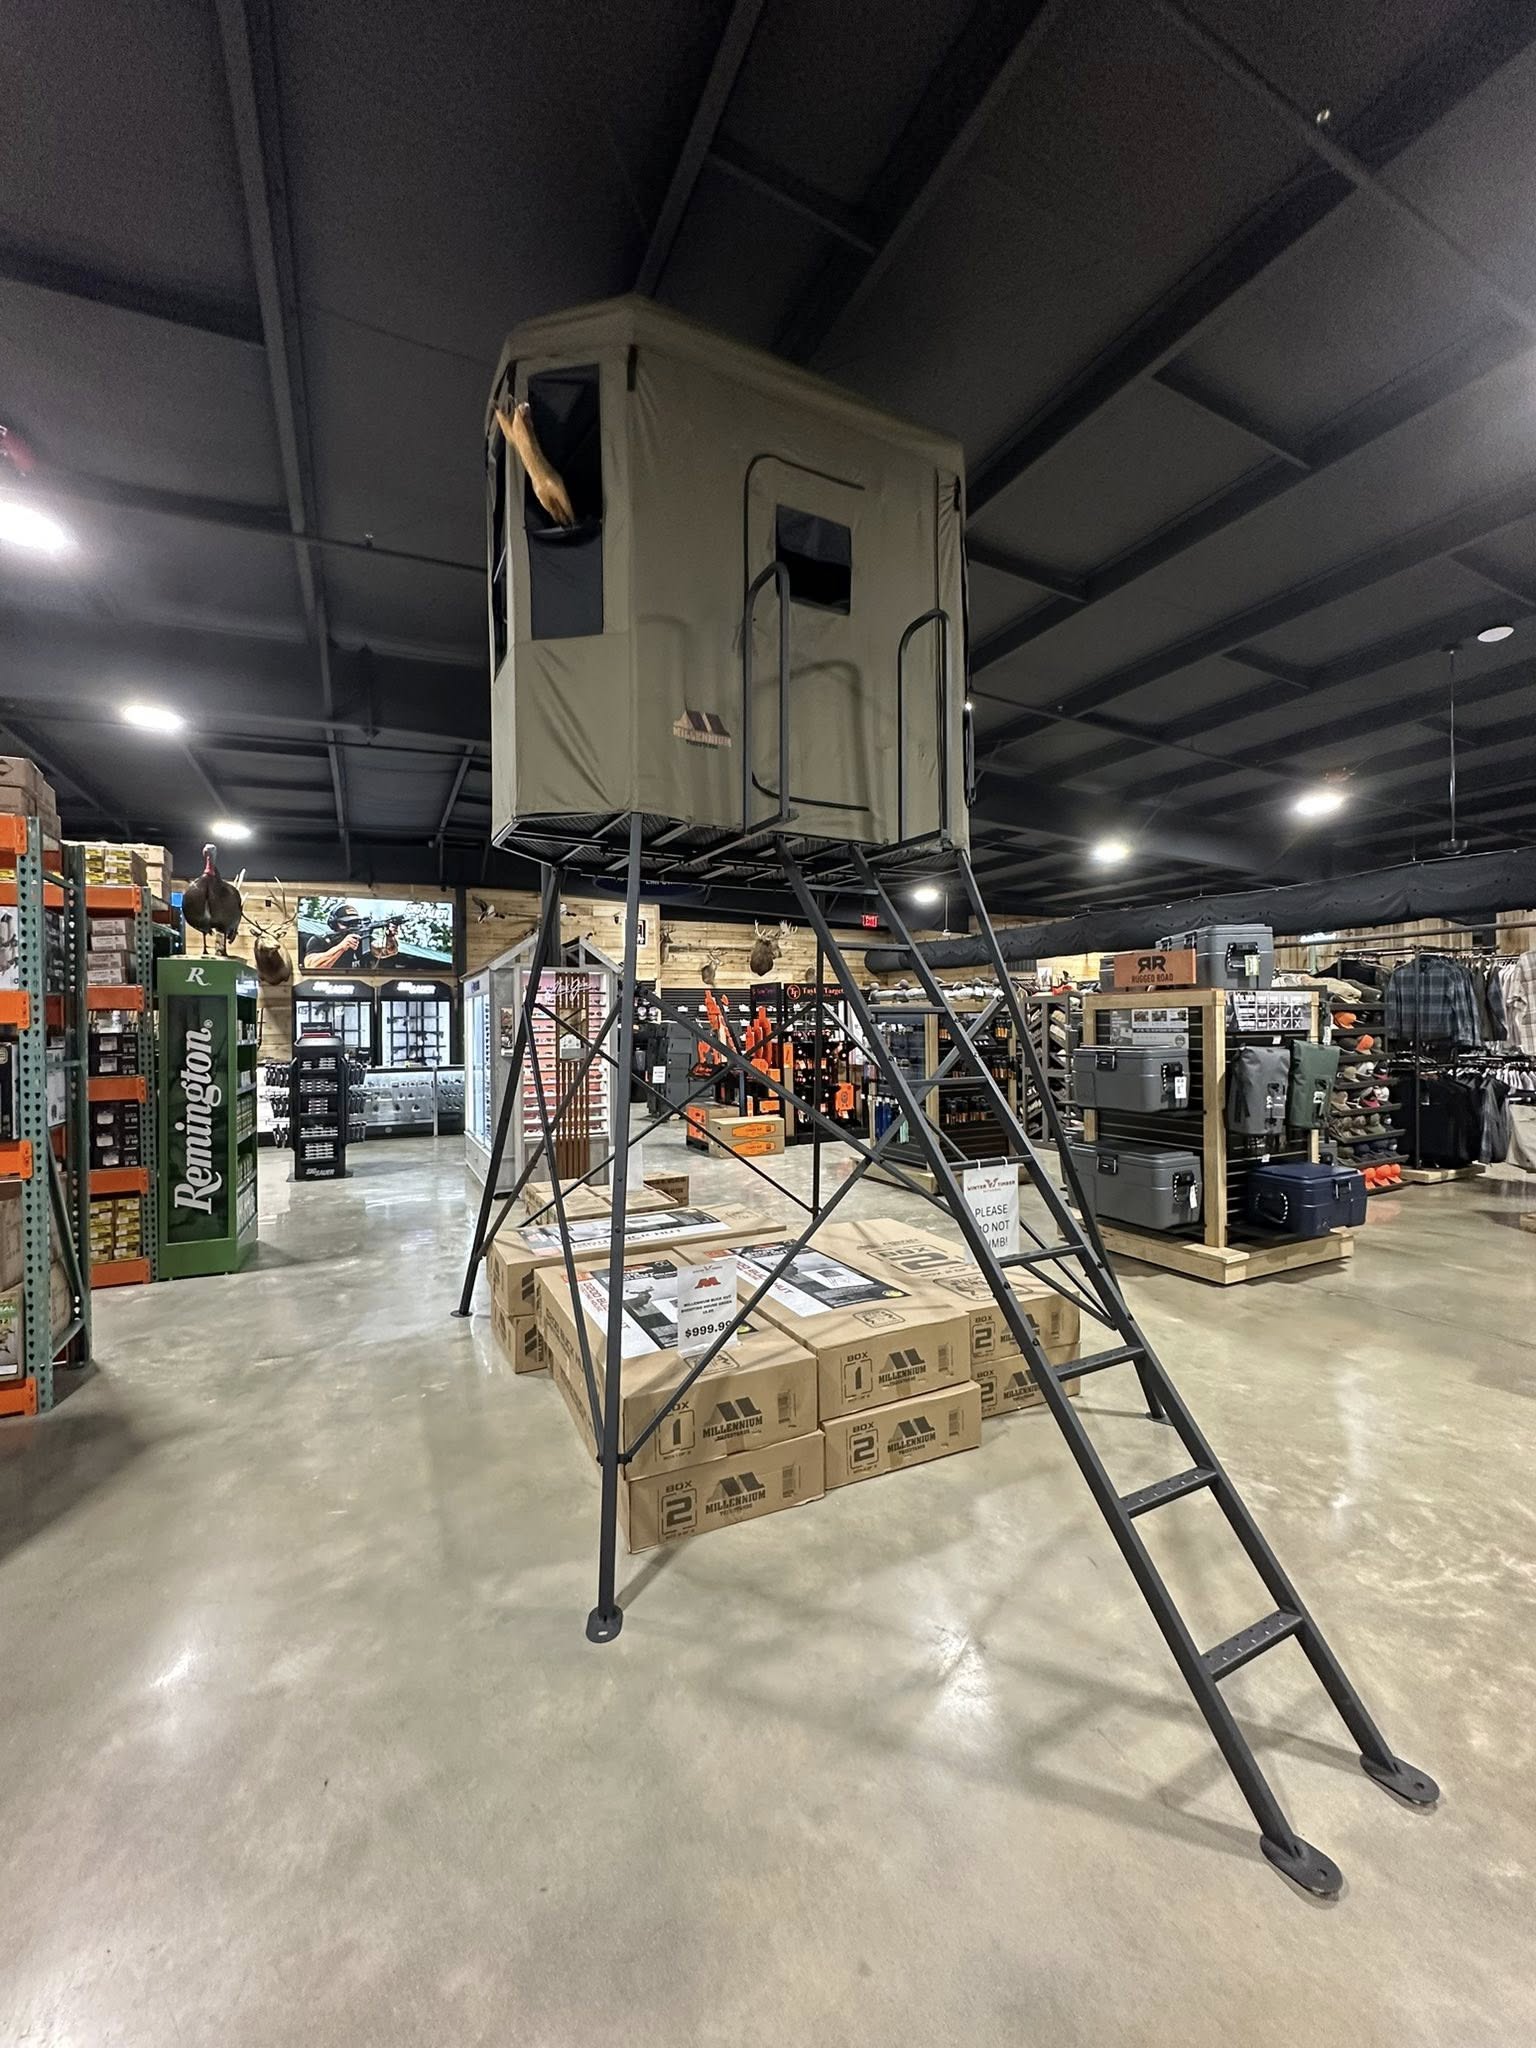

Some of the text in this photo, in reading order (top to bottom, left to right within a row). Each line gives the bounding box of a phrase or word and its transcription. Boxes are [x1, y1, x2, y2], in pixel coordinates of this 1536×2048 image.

[1131, 973, 1174, 983] RUGGED ROAD
[823, 987, 845, 996] Target
[975, 1204, 1008, 1218] PLEASE
[980, 1220, 1010, 1234] O NOT
[878, 1247, 932, 1257] BOX
[888, 1252, 965, 1270] 2
[975, 1315, 993, 1323] BOX
[975, 1327, 992, 1350] 2
[847, 1351, 869, 1363] BOX
[855, 1366, 862, 1390] 1
[878, 1364, 926, 1384] MILLENNIUM
[980, 1381, 994, 1404] 2
[1003, 1384, 1041, 1400] MILLENNIU
[672, 1418, 682, 1446] 1
[702, 1415, 764, 1439] MILLENNIUM
[852, 1421, 875, 1433] BOX
[853, 1436, 875, 1462] 2
[887, 1432, 936, 1453] MILLENNIUM
[665, 1480, 693, 1494] BOX
[705, 1489, 766, 1515] MILLENNIUM
[666, 1495, 693, 1528] 2
